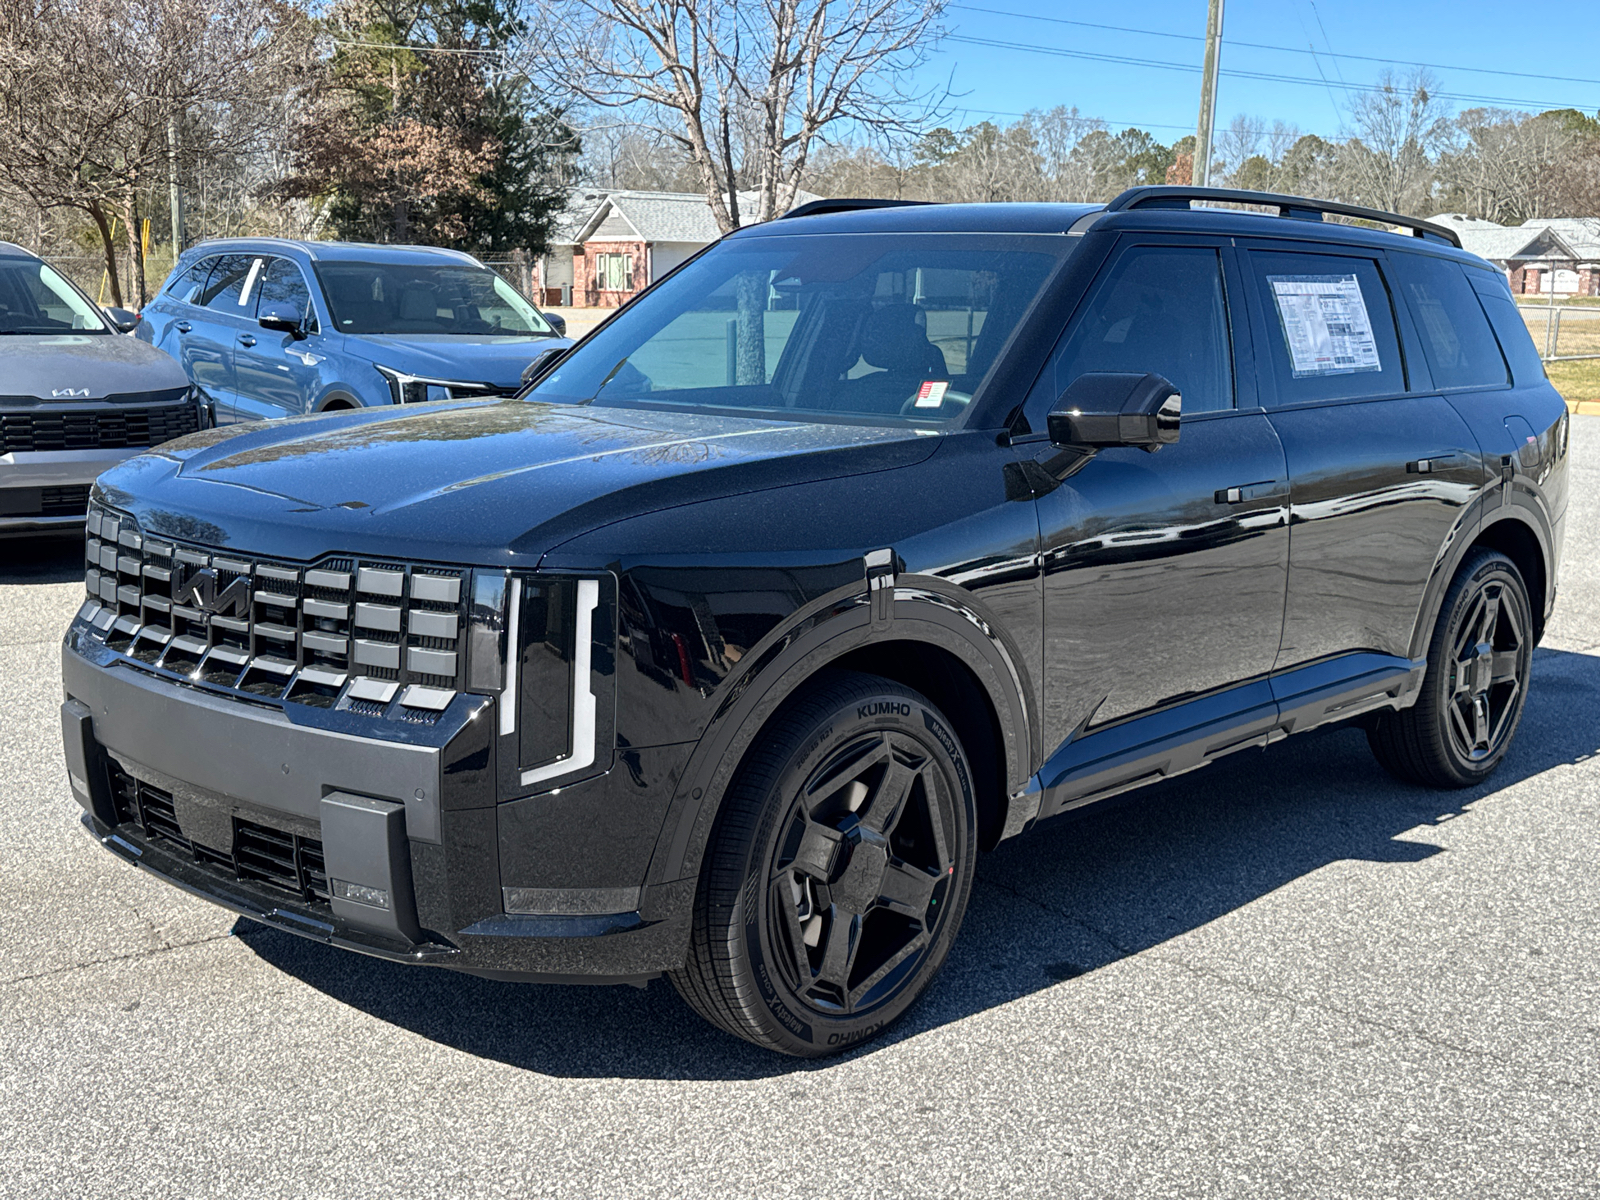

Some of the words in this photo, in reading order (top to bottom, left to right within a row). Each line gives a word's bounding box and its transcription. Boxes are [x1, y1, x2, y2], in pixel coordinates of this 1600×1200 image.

[857, 702, 911, 719] KUMHO
[820, 727, 834, 743] R21
[956, 763, 967, 792] SOLUS
[758, 963, 774, 995] SOLUS
[827, 1020, 884, 1046] KUMHO
